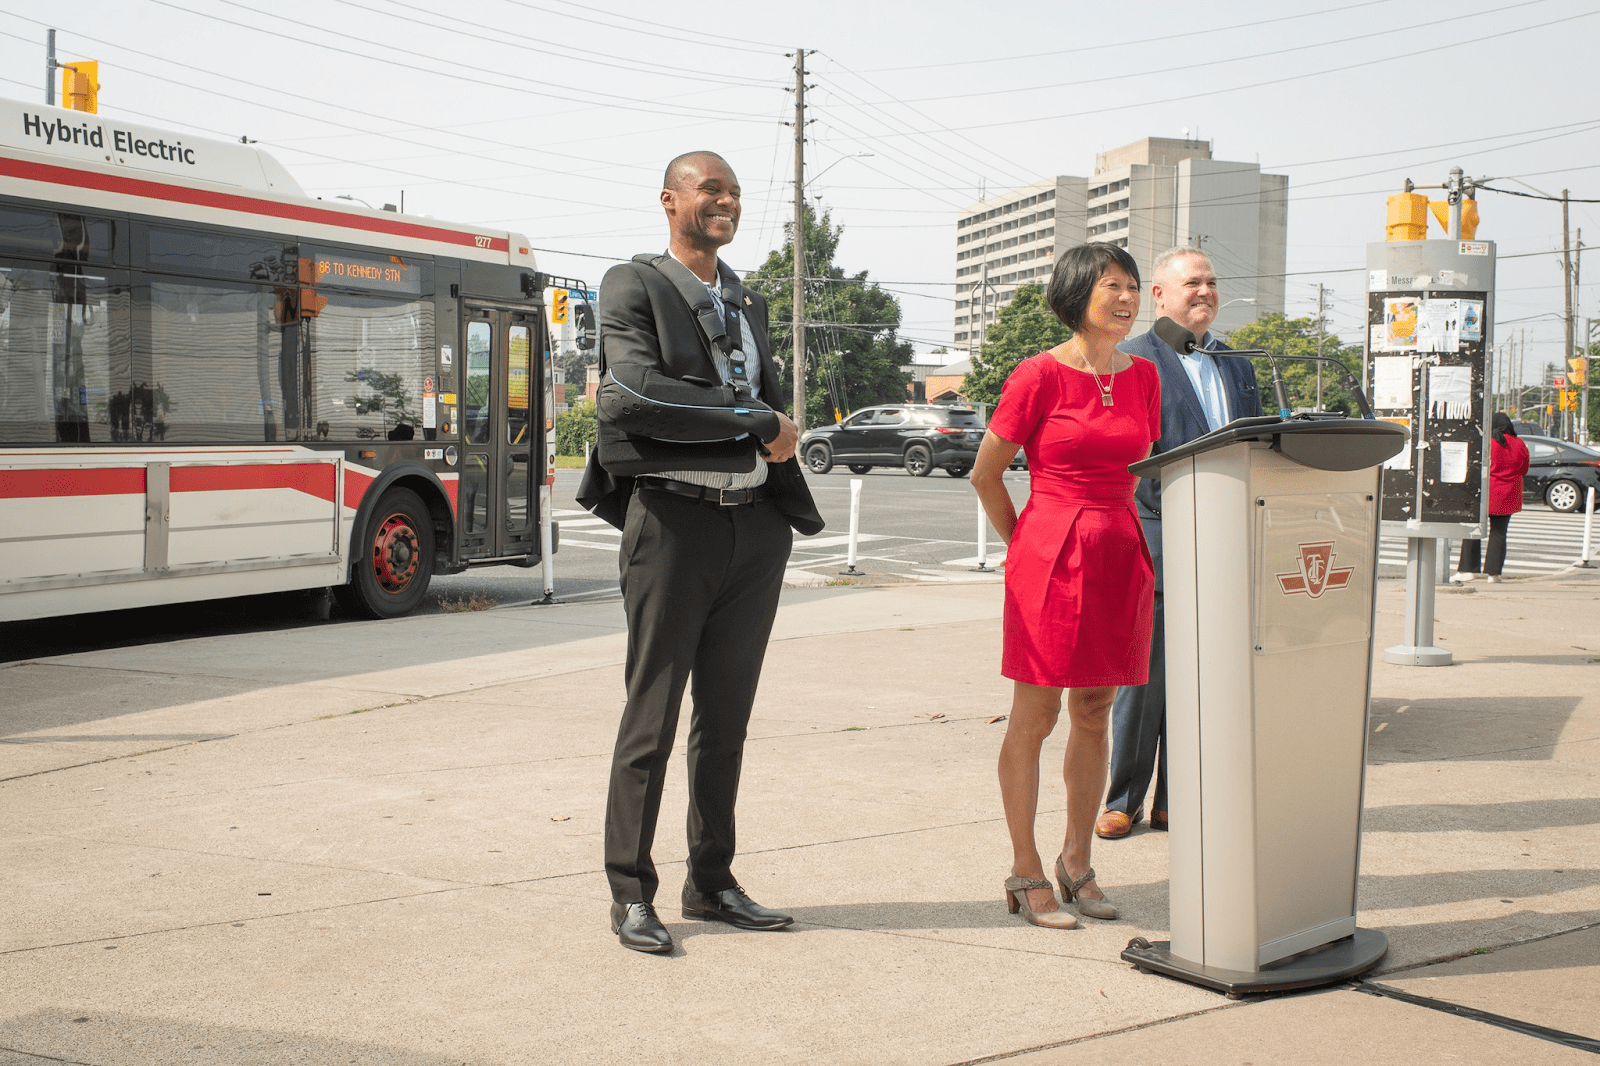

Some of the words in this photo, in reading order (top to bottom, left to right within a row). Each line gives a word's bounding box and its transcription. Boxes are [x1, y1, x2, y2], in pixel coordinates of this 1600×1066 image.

[23, 112, 104, 149] Hybrid
[113, 129, 196, 165] Electric
[474, 235, 492, 249] 1277
[318, 260, 331, 275] 86
[332, 262, 345, 276] TO
[346, 263, 382, 280] KENNEDY
[385, 268, 401, 282] STN
[1391, 275, 1415, 285] Messa
